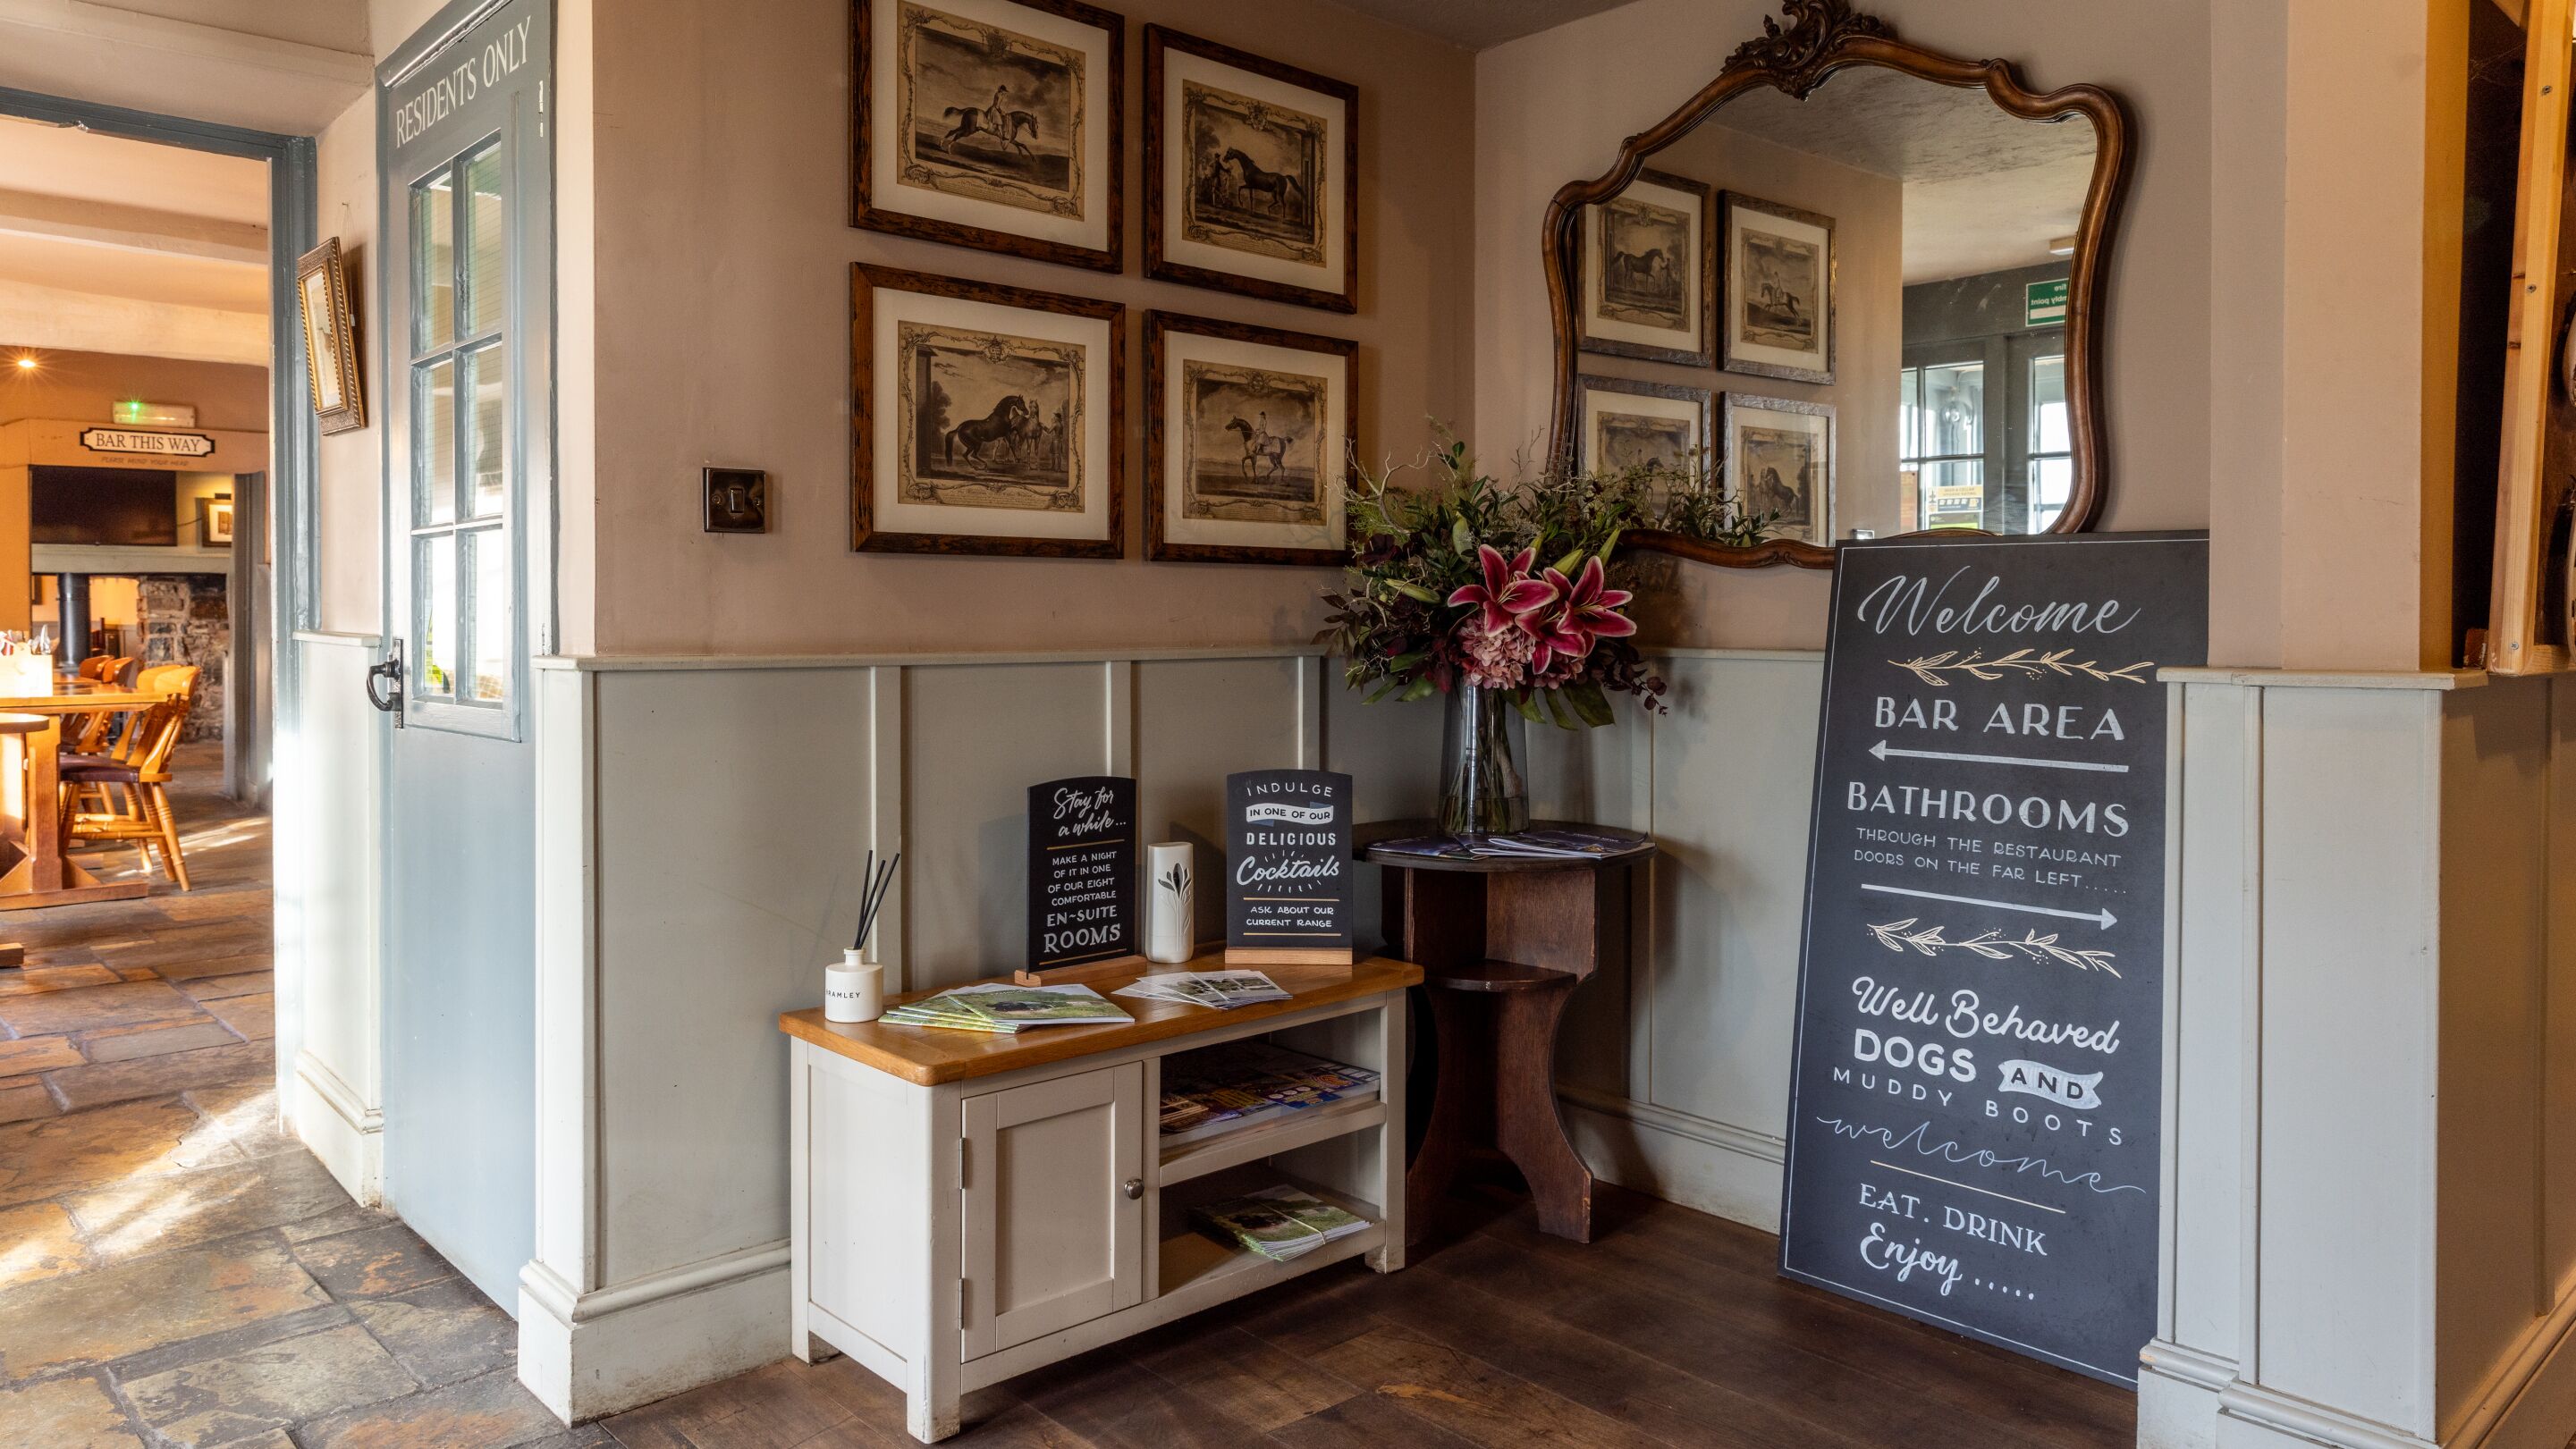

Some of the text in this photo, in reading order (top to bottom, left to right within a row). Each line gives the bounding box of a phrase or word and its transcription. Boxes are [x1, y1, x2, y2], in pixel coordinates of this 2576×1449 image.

[396, 15, 531, 148] RESIDENTS ONLY
[96, 433, 201, 452] BAR THIS WAY
[1857, 565, 2141, 636] Welcome
[1873, 694, 2124, 741] BAR AREA
[1052, 786, 1114, 820] Stay for
[1246, 782, 1333, 797] INDULGE
[1249, 807, 1331, 821] IN ONE OF OUR
[1846, 781, 2130, 838] BATHROOMS
[1058, 826, 1071, 838] a
[1246, 832, 1337, 846] DELICIOUS
[1854, 826, 2122, 869] THROUGH THE RESTAURANT
[1051, 850, 1118, 867] MAKE A NIGHT
[1052, 864, 1112, 880] OF IT IN ONE
[1236, 855, 1340, 886] Cocktails
[1853, 847, 1906, 869] DOORS
[1913, 855, 1940, 873] ON
[1946, 859, 1982, 878] THE
[1991, 864, 2027, 882] FAR
[1047, 877, 1115, 895] OF OUR EIGHT
[1052, 890, 1117, 906] COMFORTABLE
[1246, 918, 1333, 930] CURRENT RANGE
[1250, 906, 1335, 916] ASK ABOUT OUR
[1043, 922, 1121, 954] ROOMS
[1851, 974, 2121, 1055] Well Behaved
[1854, 1028, 2084, 1101] DOGS AND
[1833, 1066, 2123, 1147] MUDDY BOOTS
[1816, 1116, 2147, 1194] welcome
[1943, 1206, 2048, 1258] DRINK
